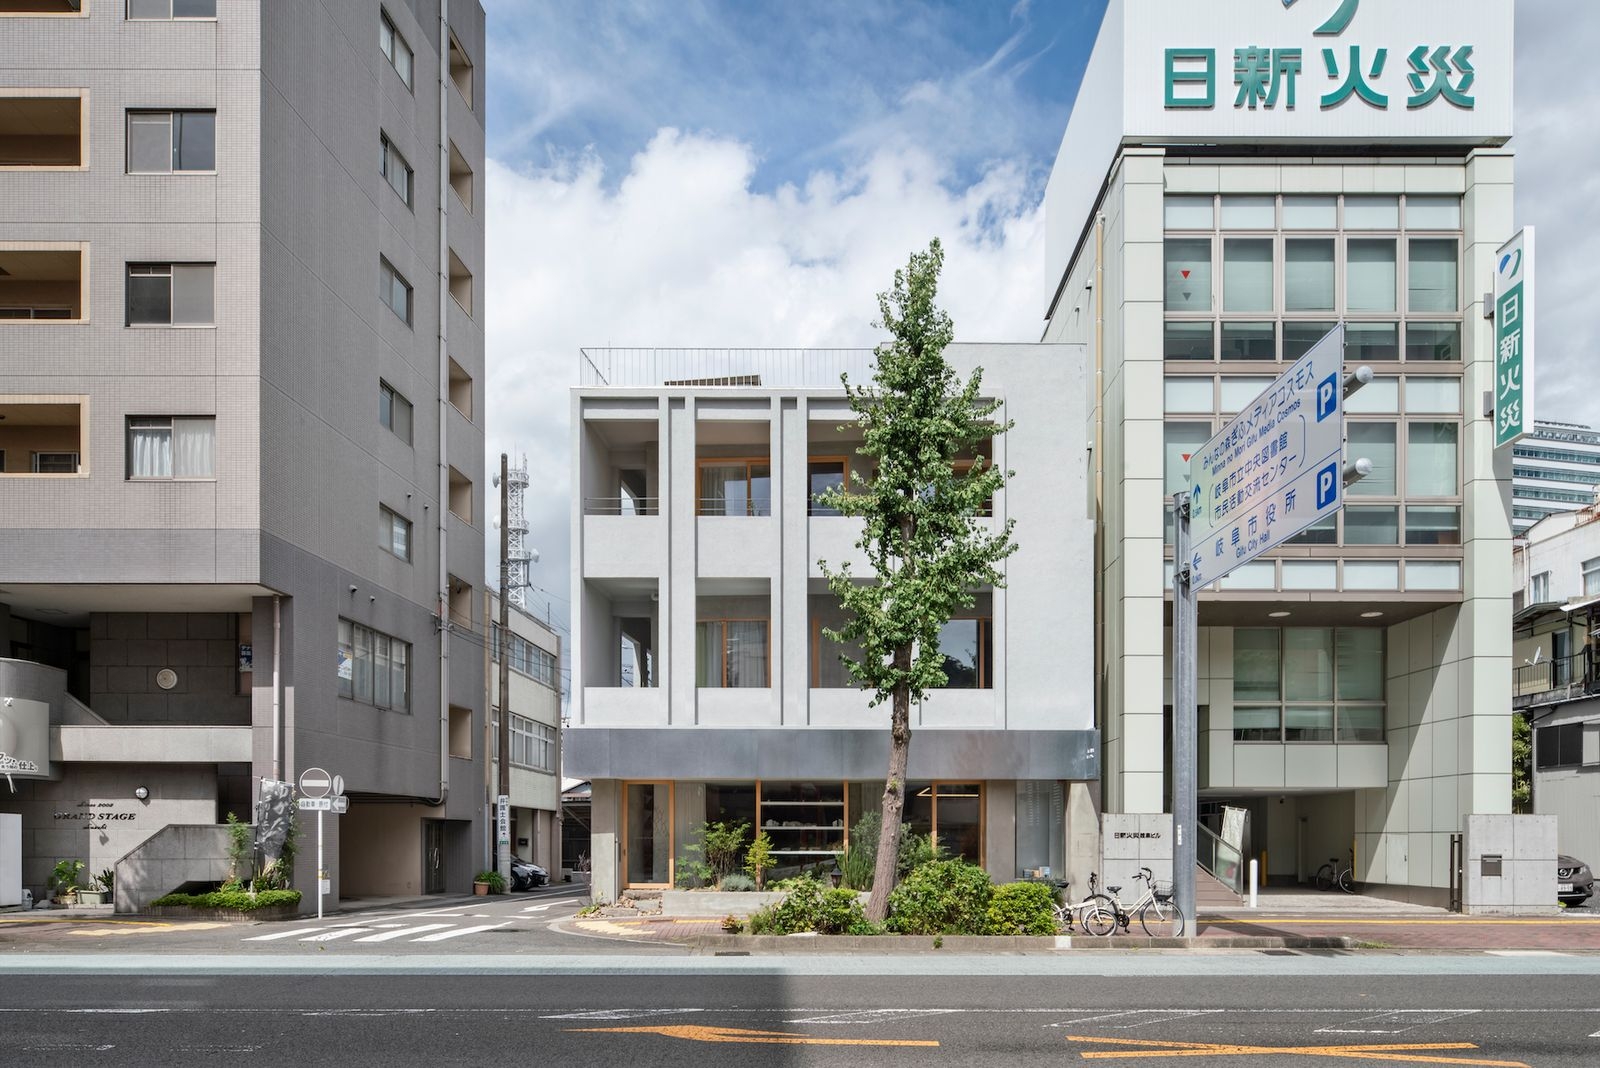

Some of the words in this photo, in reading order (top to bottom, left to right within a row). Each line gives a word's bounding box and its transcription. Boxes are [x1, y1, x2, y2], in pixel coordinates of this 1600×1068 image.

[1164, 45, 1476, 110] 日新火災
[1500, 293, 1521, 435] 日新火災
[1203, 361, 1314, 470] みんなの森ぎふメディアコスモス
[1234, 443, 1246, 461] Mori
[1246, 434, 1258, 449] Gifu
[1259, 419, 1276, 439] Media
[1276, 398, 1301, 424] Cosmos
[1214, 431, 1288, 499] 岐阜市立中央図書館
[1214, 454, 1297, 520] 市民活動交流センター
[1215, 488, 1297, 557] 岐阜市役所
[1236, 544, 1246, 559] Gifu
[1247, 538, 1258, 552] City
[1259, 529, 1271, 544] Hall
[97, 811, 137, 821] STAGE
